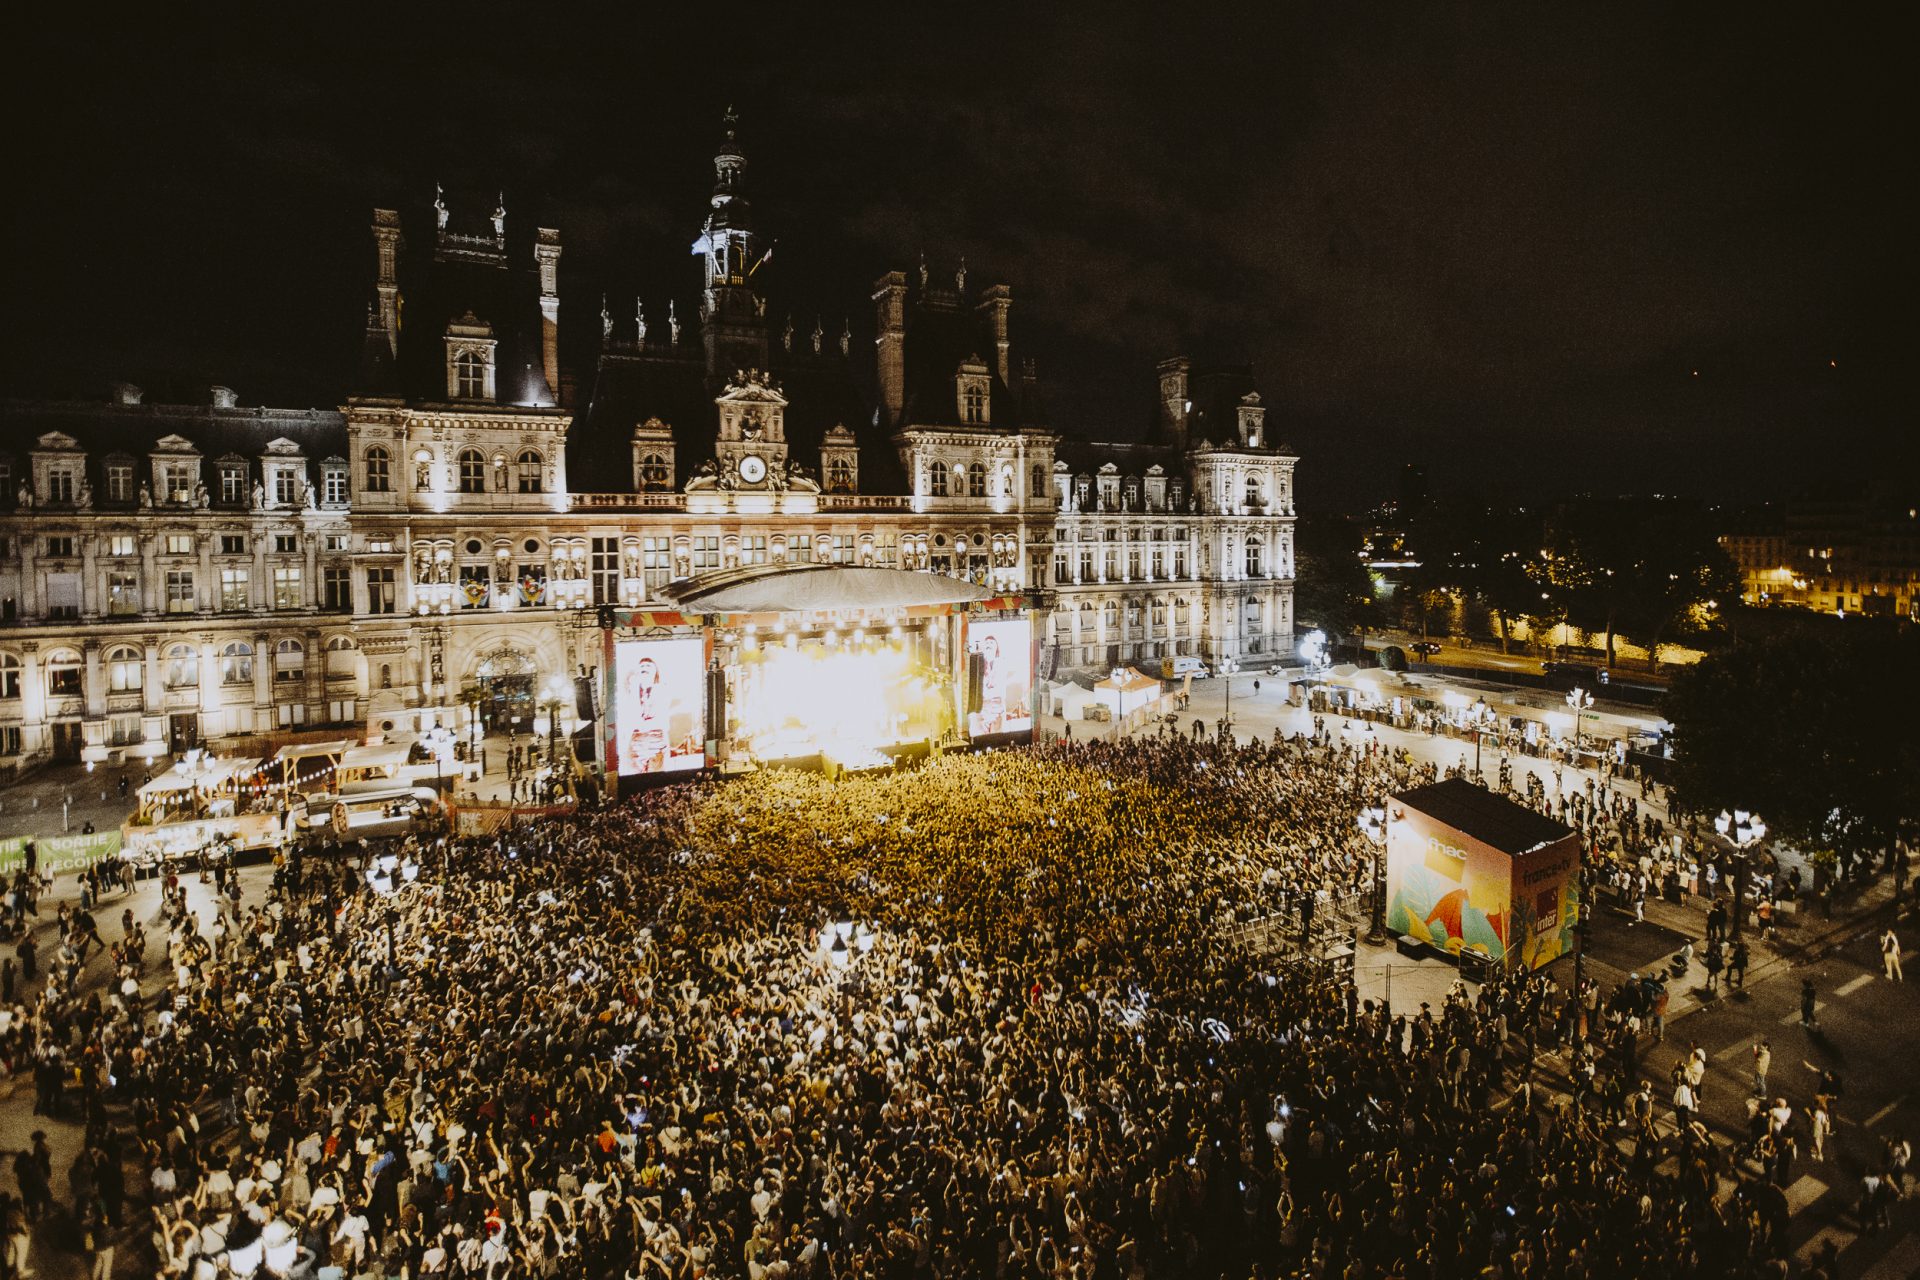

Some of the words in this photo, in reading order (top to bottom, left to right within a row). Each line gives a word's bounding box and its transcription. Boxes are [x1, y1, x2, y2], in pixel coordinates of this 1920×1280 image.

[52, 833, 108, 850] SORTIE
[1427, 837, 1468, 861] fnac
[73, 848, 87, 857] DE
[1537, 914, 1557, 932] inter
